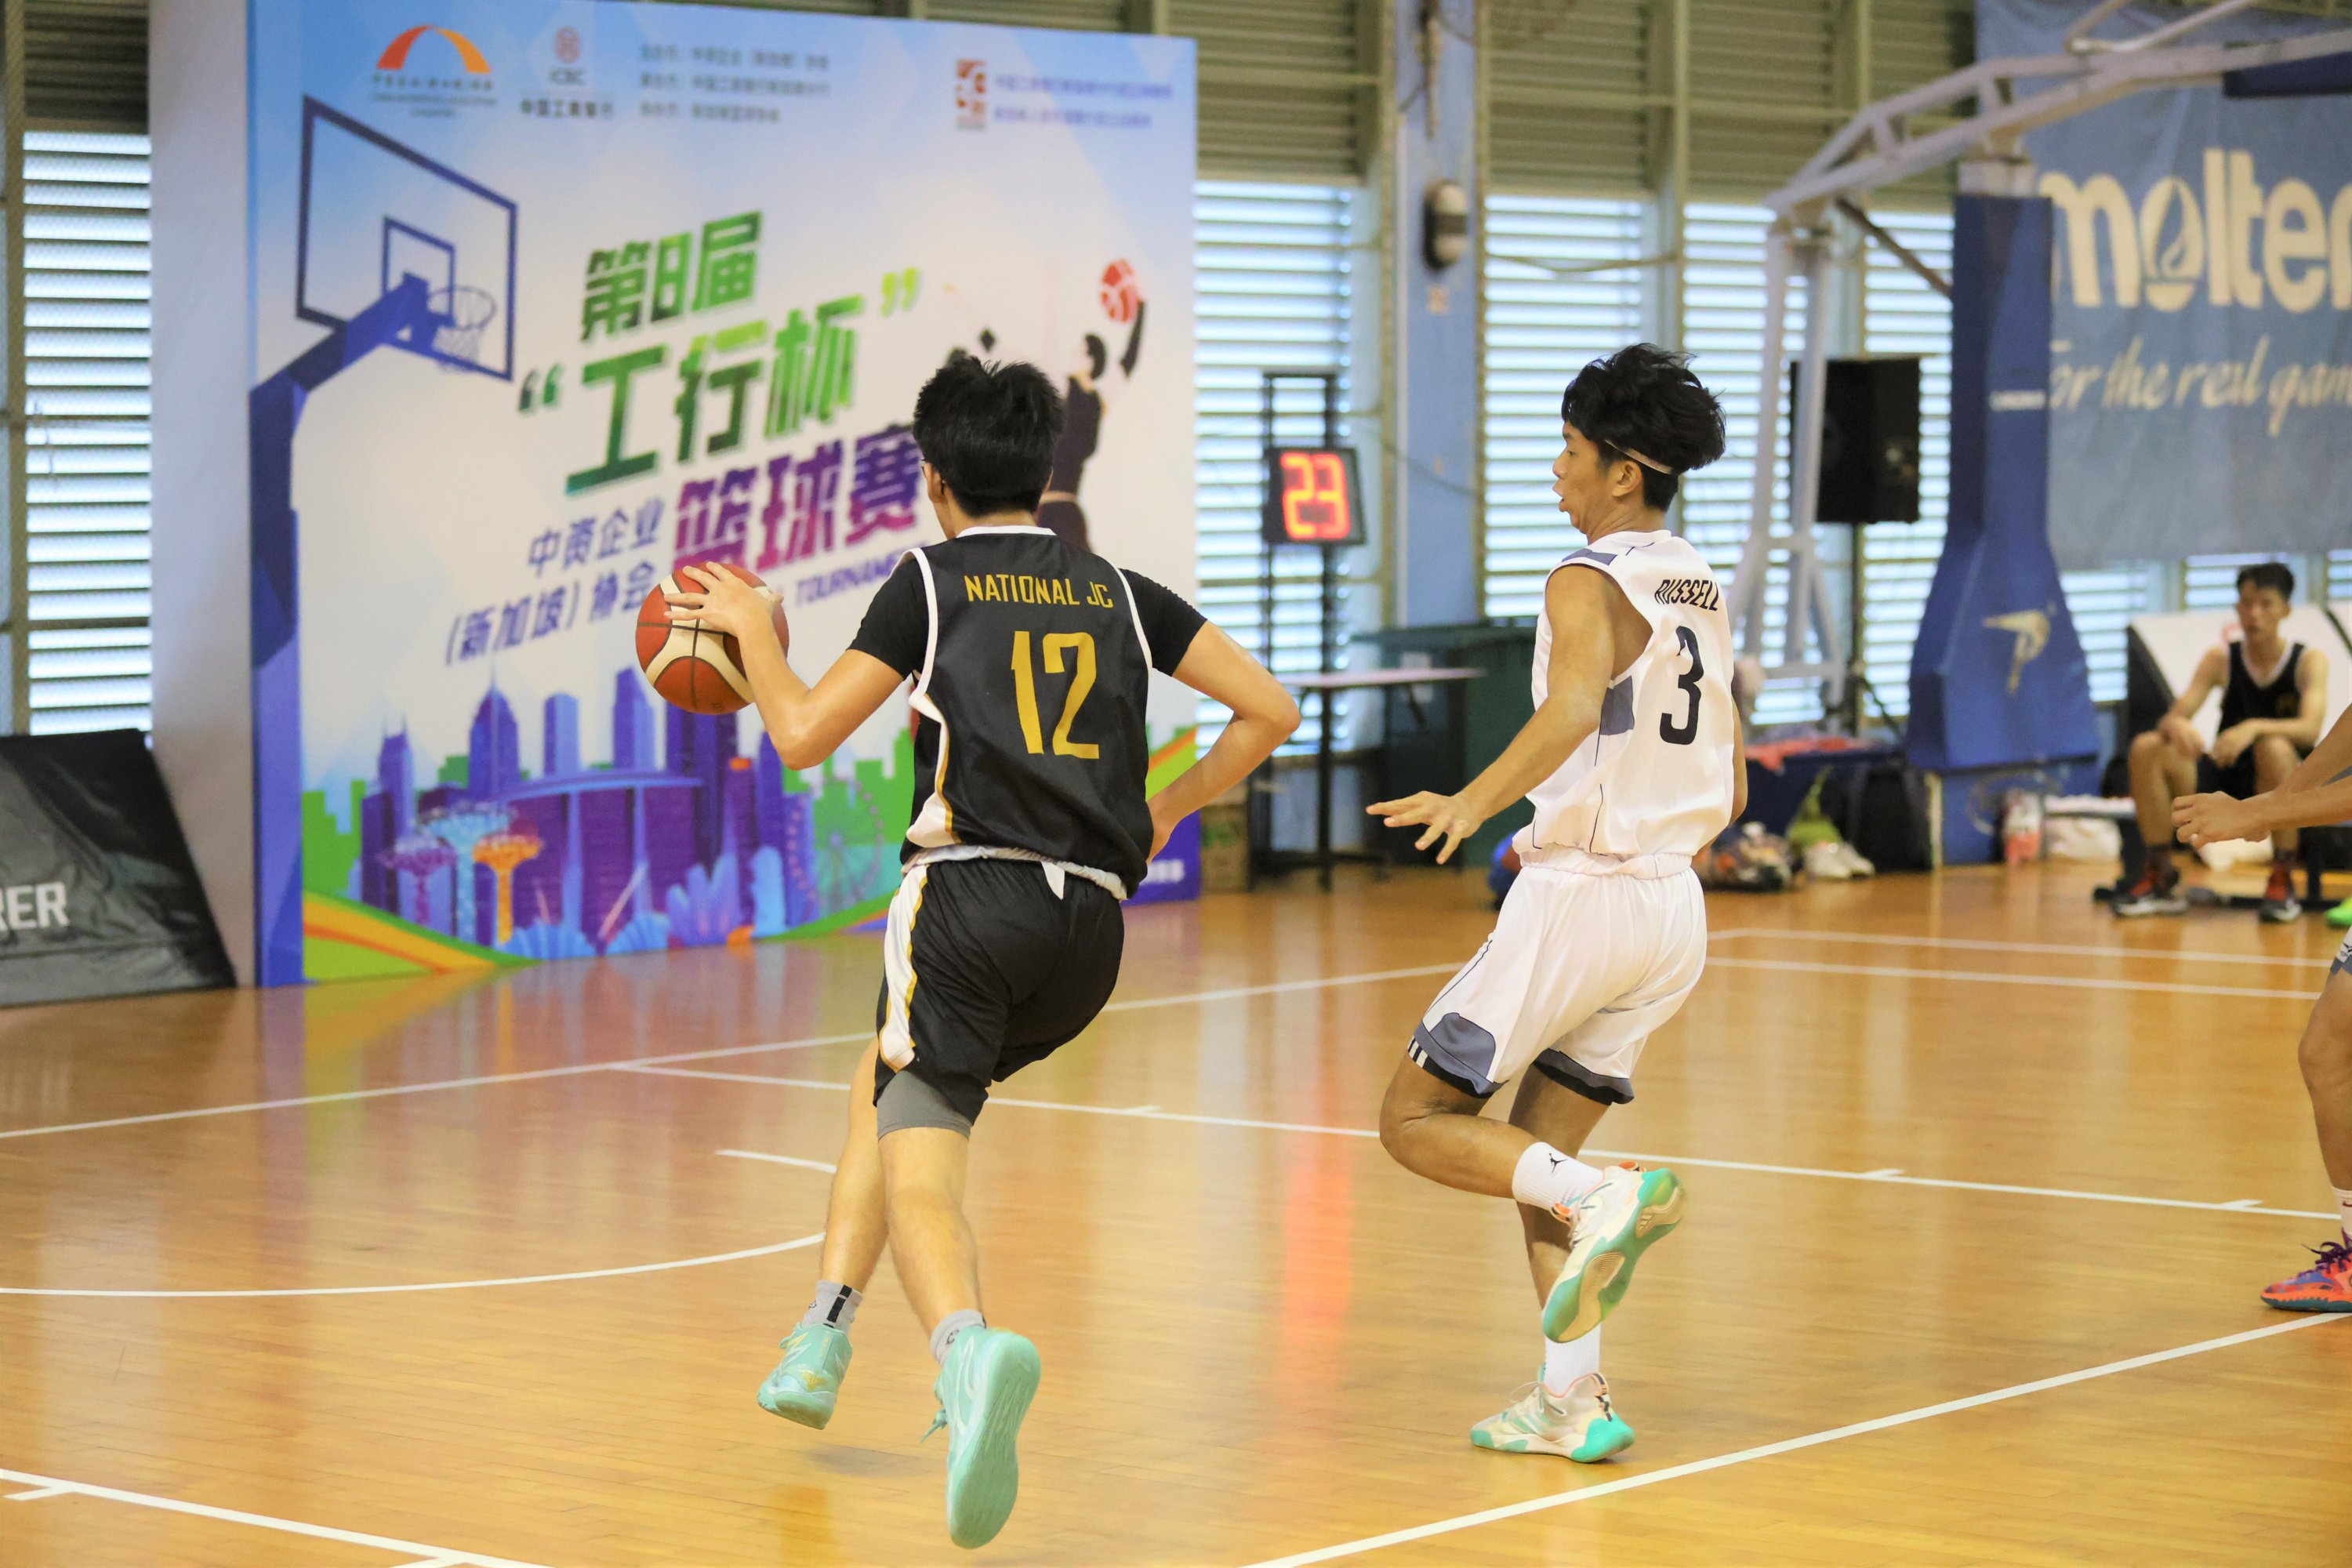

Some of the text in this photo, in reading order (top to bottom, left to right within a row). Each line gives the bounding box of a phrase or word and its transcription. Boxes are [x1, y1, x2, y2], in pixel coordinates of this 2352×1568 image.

[2174, 332, 2270, 408] real
[1280, 452, 1350, 539] 23
[964, 574, 1114, 608] NATIONAL JC
[1654, 579, 1719, 612] RUSSELL
[1011, 630, 1100, 759] 12
[1659, 625, 1704, 746] 3
[0, 881, 70, 931] ER
